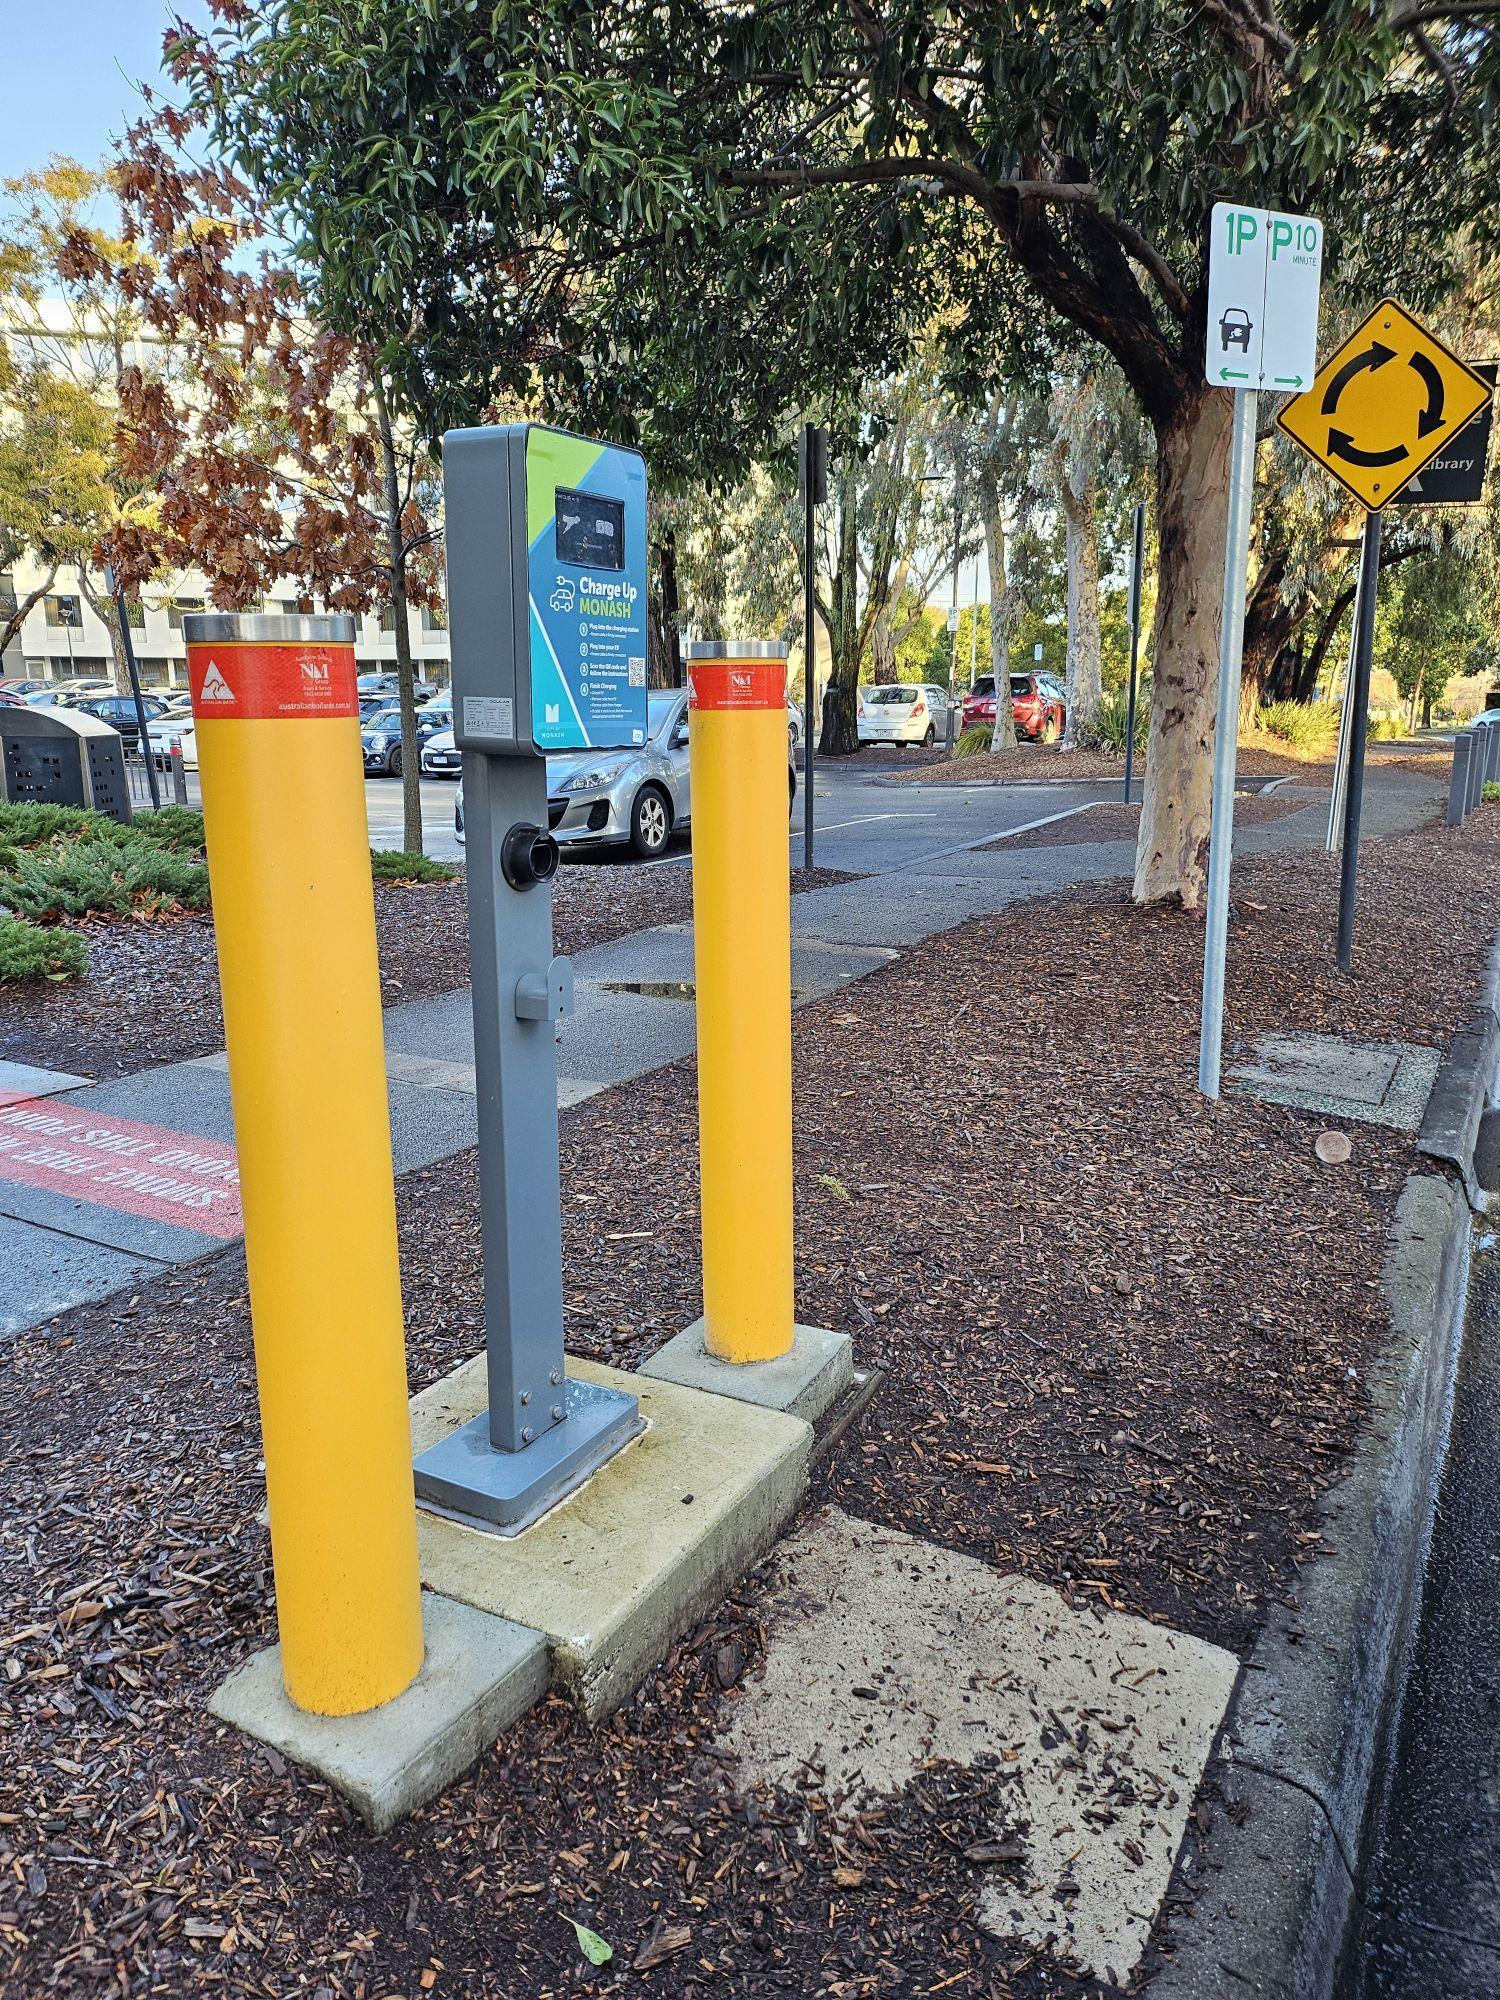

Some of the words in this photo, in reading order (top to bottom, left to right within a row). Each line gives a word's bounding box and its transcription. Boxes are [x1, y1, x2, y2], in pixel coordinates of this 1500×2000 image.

[1226, 212, 1258, 256] 1P
[1293, 255, 1317, 267] MINUTE
[579, 576, 621, 601] Charge
[622, 581, 637, 603] Up
[579, 597, 631, 619] MONASH
[69, 1128, 156, 1157] THIS
[91, 1166, 229, 1208] SMOKE
